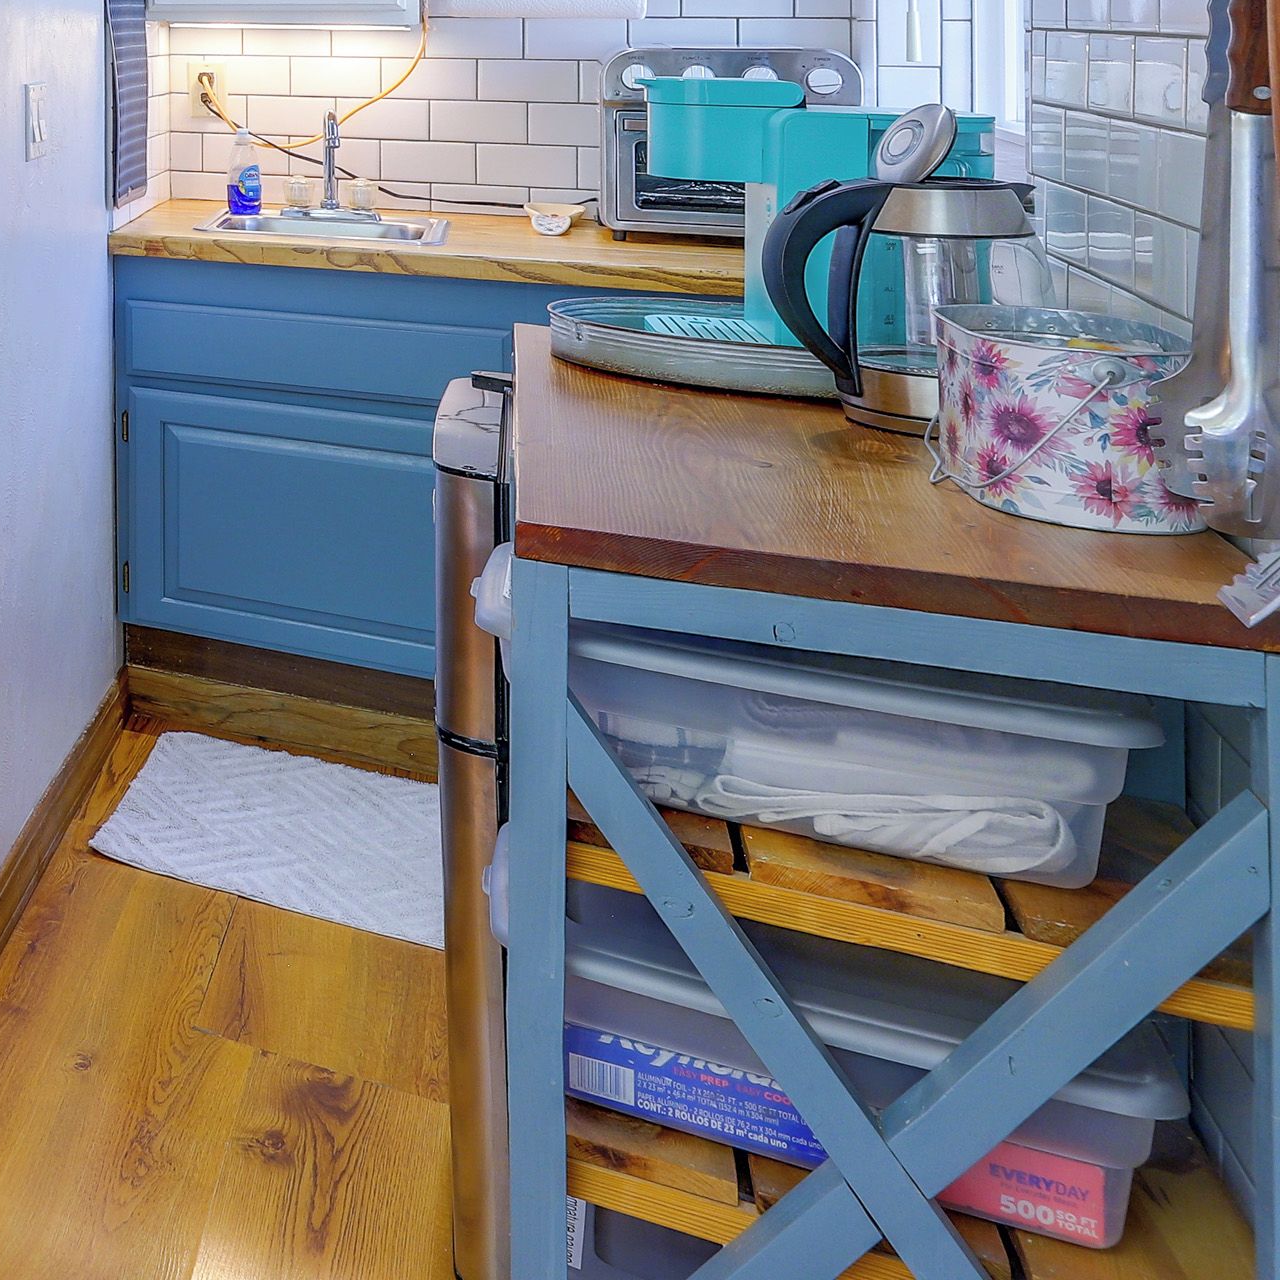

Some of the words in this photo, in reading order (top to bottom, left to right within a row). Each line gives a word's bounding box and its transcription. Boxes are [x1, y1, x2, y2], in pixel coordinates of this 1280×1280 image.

[673, 1081, 687, 1092] FOIL
[778, 1110, 799, 1124] TOTAL
[700, 1074, 729, 1087] PREP
[764, 1091, 792, 1105] COO
[637, 1098, 667, 1115] CONT.:
[674, 1108, 709, 1127] ROLLOS
[710, 1118, 722, 1132] DE
[723, 1123, 735, 1135] 23
[748, 1130, 769, 1144] cada
[770, 1139, 788, 1150] uno
[791, 1135, 808, 1146] cada
[988, 1163, 1089, 1202] EVERYDAY
[1000, 1194, 1055, 1225] 500
[1055, 1209, 1077, 1221] SQ
[1081, 1216, 1098, 1228] FT
[1057, 1219, 1099, 1239] TOTAL
